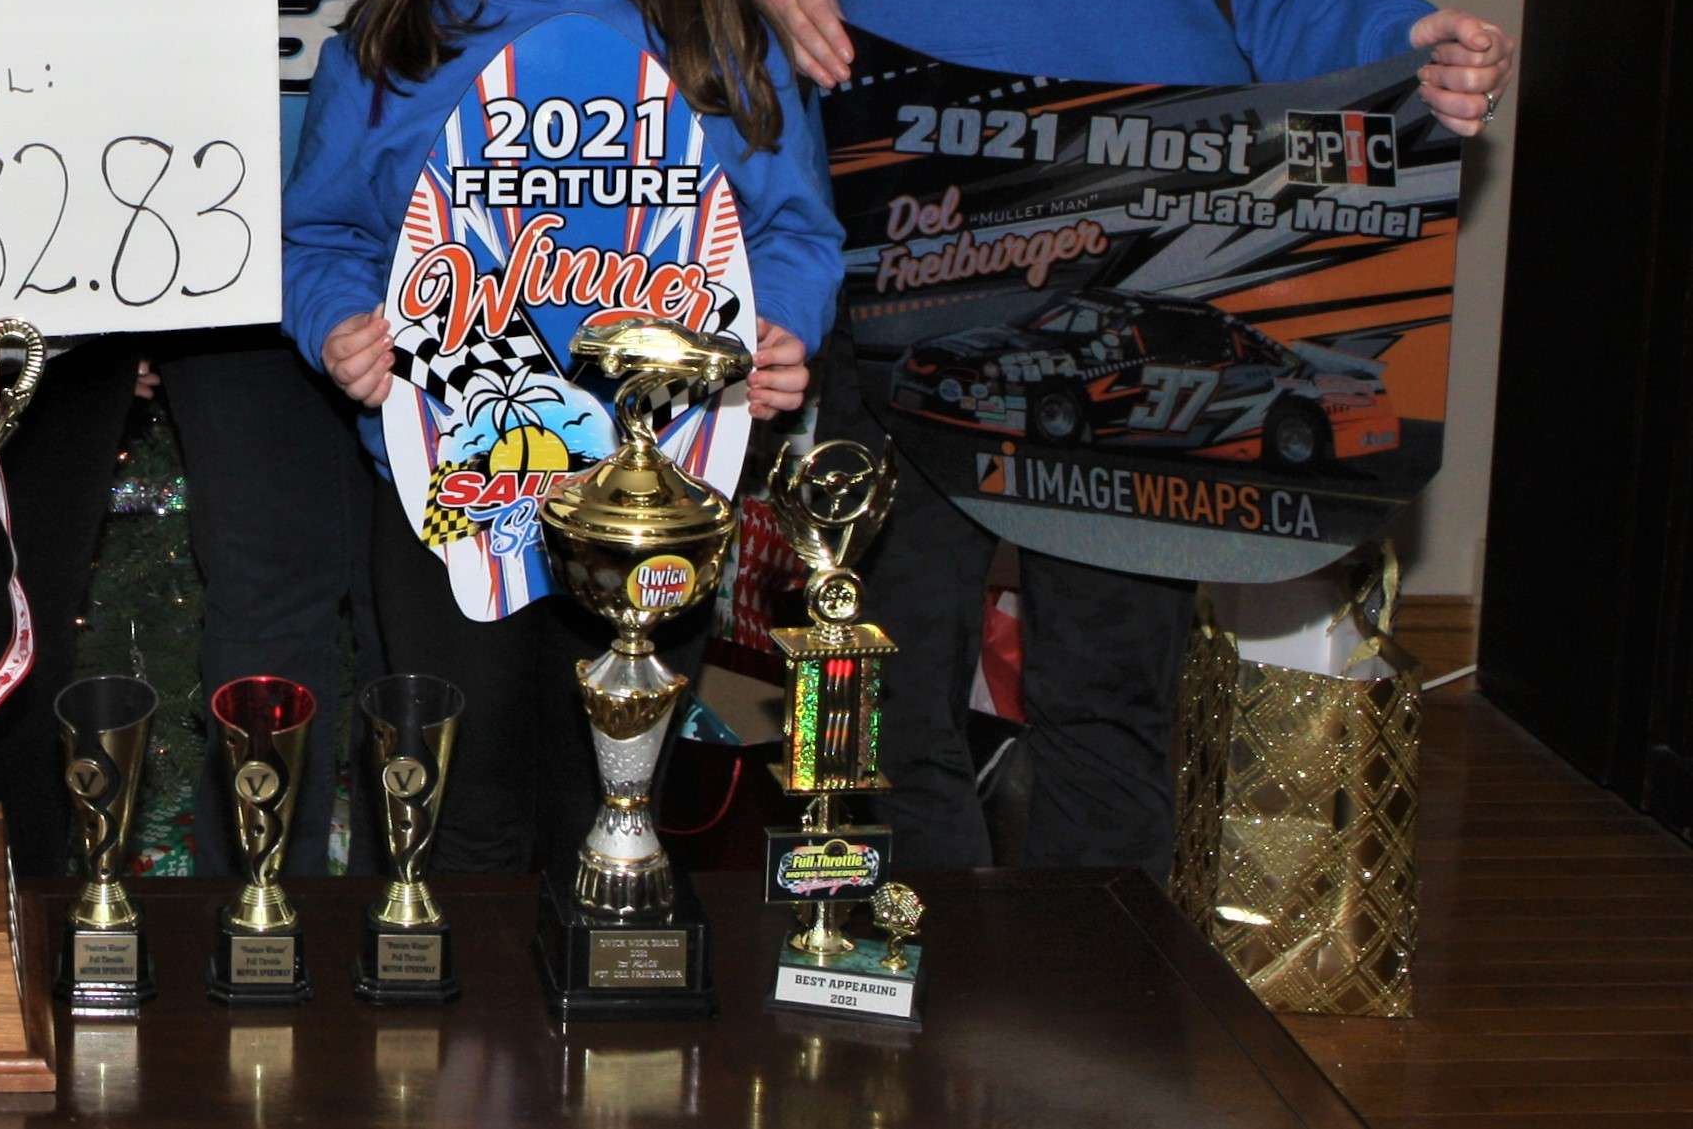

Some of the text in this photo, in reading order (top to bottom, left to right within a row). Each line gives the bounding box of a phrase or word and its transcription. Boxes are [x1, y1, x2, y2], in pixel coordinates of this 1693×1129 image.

[482, 97, 670, 160] 2021
[894, 105, 1393, 174] 2021 Most EPIC
[452, 165, 702, 209] FEATURE
[887, 184, 963, 241] Del
[1192, 191, 1278, 228] Late
[1294, 199, 1422, 238] Model
[399, 214, 714, 356] Winner
[877, 219, 1108, 293] Freiburger
[1128, 369, 1219, 433] 37
[1024, 457, 1320, 539] IMAGEWRAPS.CA
[792, 854, 863, 869] Full Throttle
[795, 974, 898, 998] BEST APPEARING
[830, 994, 858, 1007] 2021
